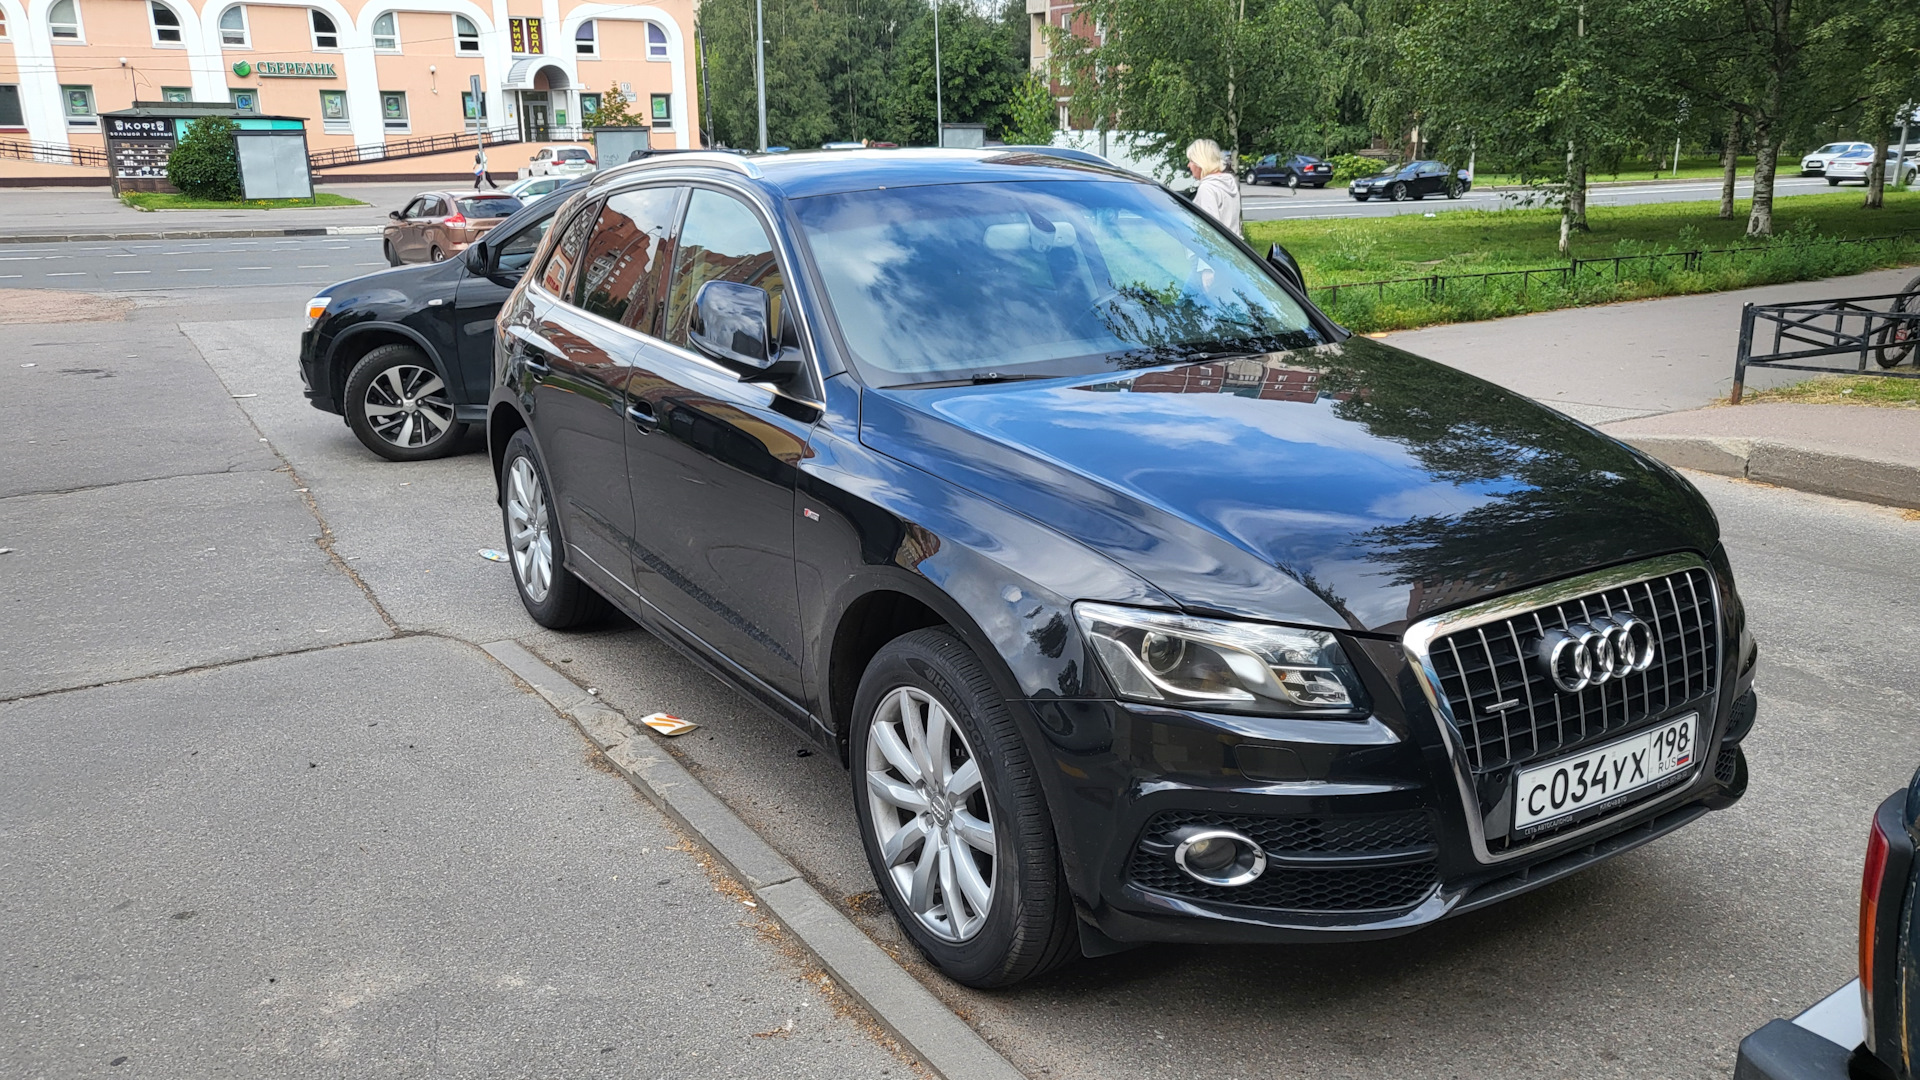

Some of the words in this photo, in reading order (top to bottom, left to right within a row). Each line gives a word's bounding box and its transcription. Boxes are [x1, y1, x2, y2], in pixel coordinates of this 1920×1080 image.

[512, 20, 523, 52] УНИУМ
[528, 20, 541, 54] ШКОЛА
[256, 61, 337, 76] СБЕРБАНК
[933, 672, 990, 760] Hankook
[1528, 748, 1646, 816] С034УХ
[1653, 722, 1689, 761] 198
[1657, 756, 1677, 774] RUS
[1524, 826, 1537, 836] СЕТЬ
